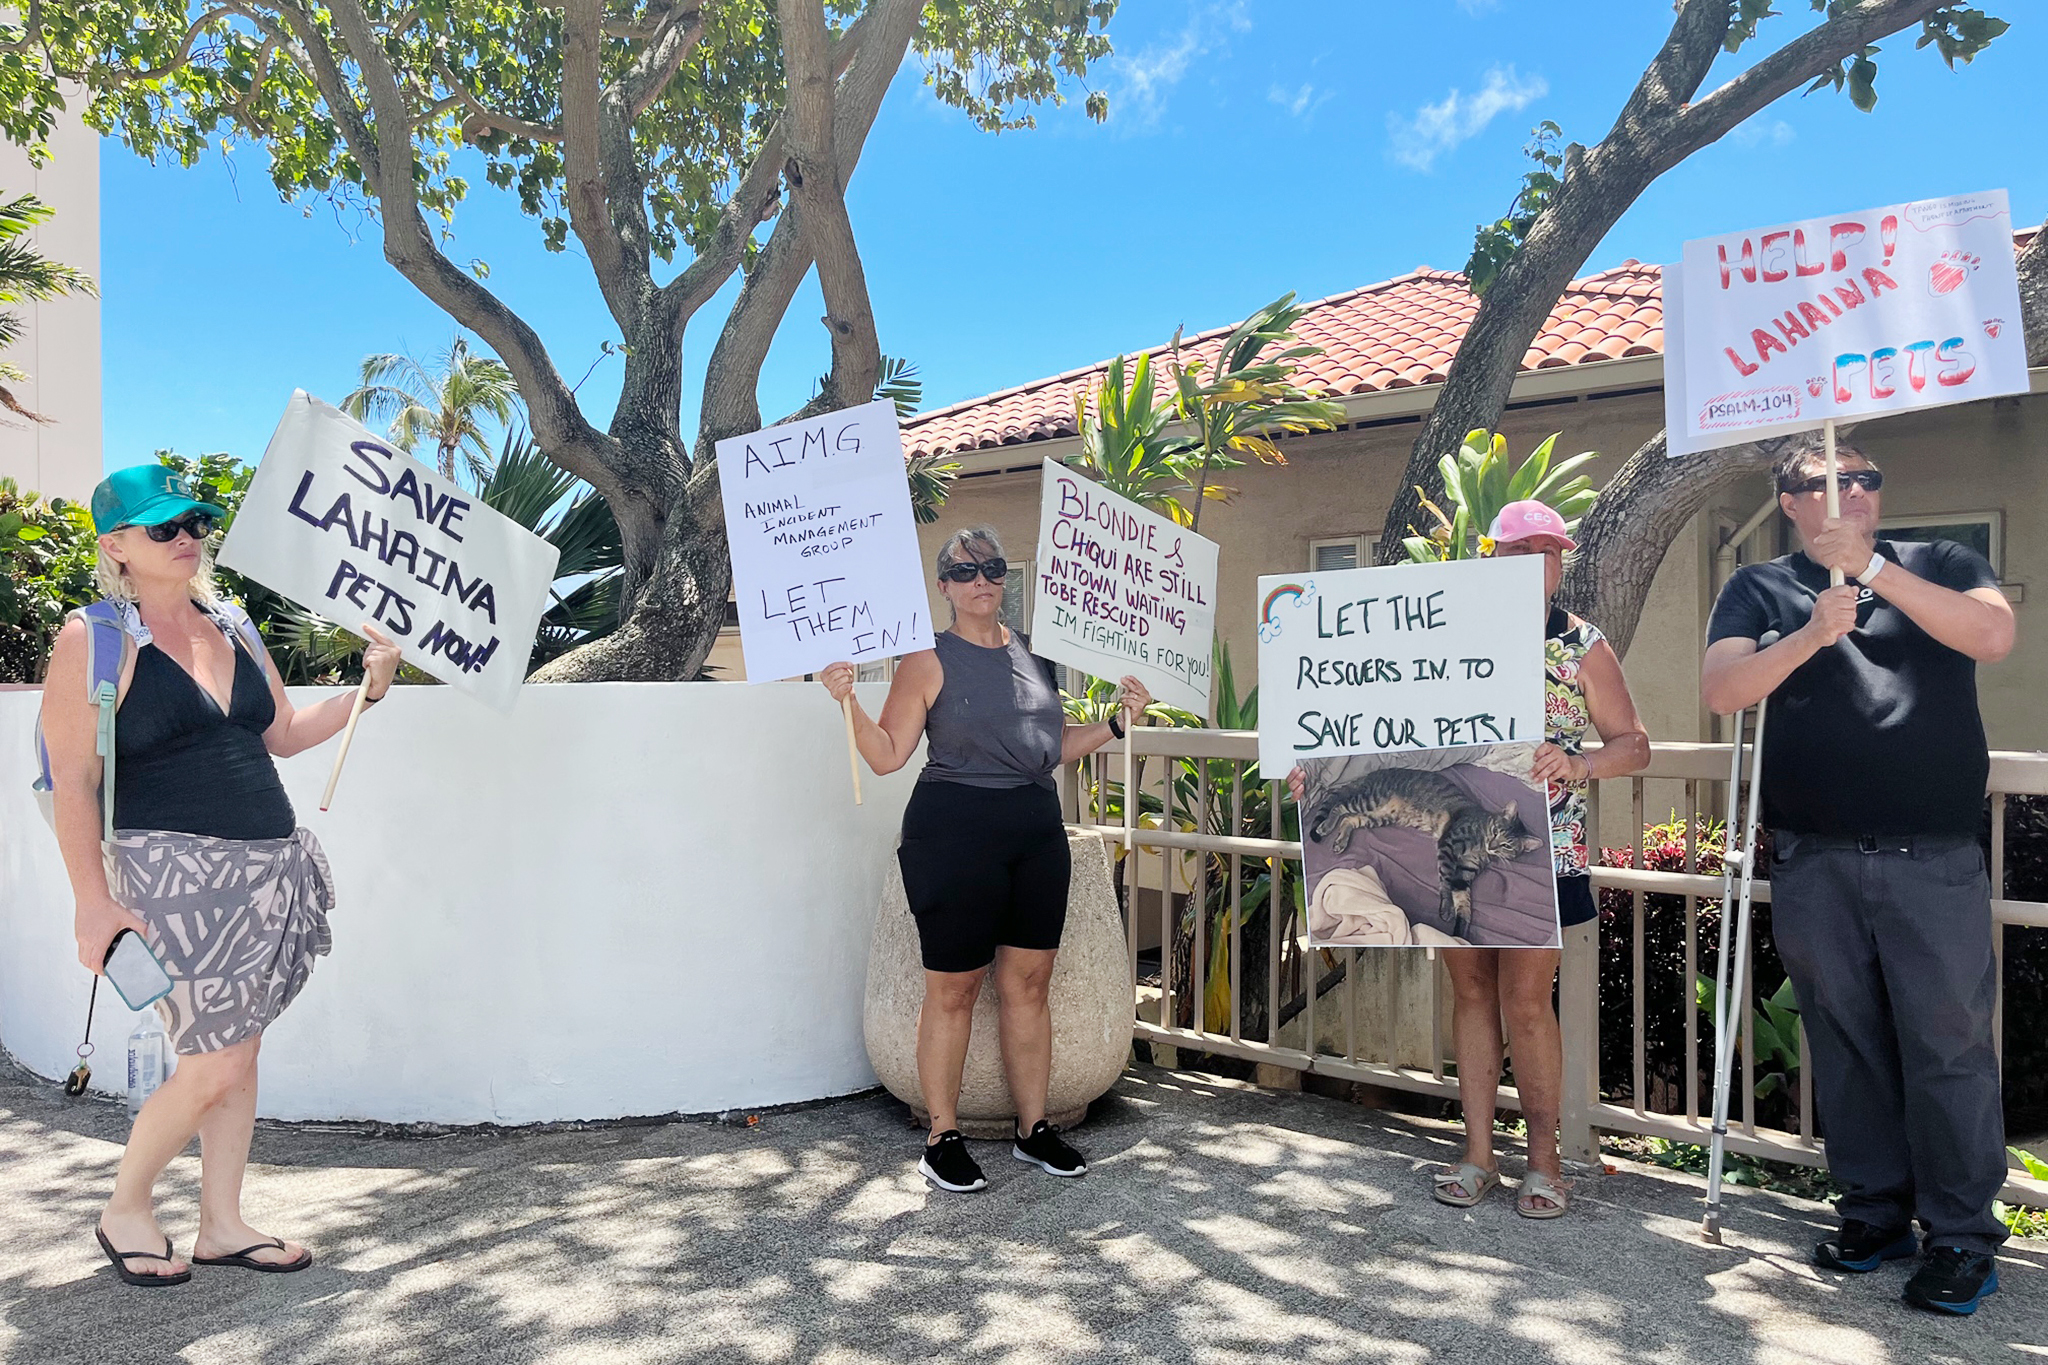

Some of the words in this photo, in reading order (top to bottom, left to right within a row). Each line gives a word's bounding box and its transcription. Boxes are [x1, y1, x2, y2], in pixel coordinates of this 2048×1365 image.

[1717, 214, 1899, 290] HELP!
[1723, 266, 1899, 377] LAHAINA
[1832, 336, 1976, 404] PETS
[1708, 393, 1792, 419] PSALM-104
[342, 440, 471, 543] SAVE
[745, 494, 806, 519] ANIMAL
[760, 505, 842, 534] INCIDENT
[774, 513, 883, 546] MANAGEMENT
[1057, 478, 1157, 552] BLONDIE
[1164, 537, 1184, 568] &
[287, 470, 497, 626] LAHAINA
[800, 537, 853, 558] GROUP
[1123, 553, 1153, 588] ARE
[325, 559, 417, 636] PETS
[761, 577, 846, 619] LET
[1082, 590, 1150, 637] RESCUED
[1317, 595, 1380, 639] LET
[1386, 589, 1447, 631] THE
[787, 600, 874, 641] THEM
[851, 612, 917, 656] IN!
[1052, 605, 1077, 635] IM
[417, 619, 501, 675] NOW!
[1296, 656, 1402, 690] RESCUERS
[1459, 658, 1494, 680] TO
[1293, 711, 1363, 750] SAVE
[1373, 716, 1428, 749] OUR
